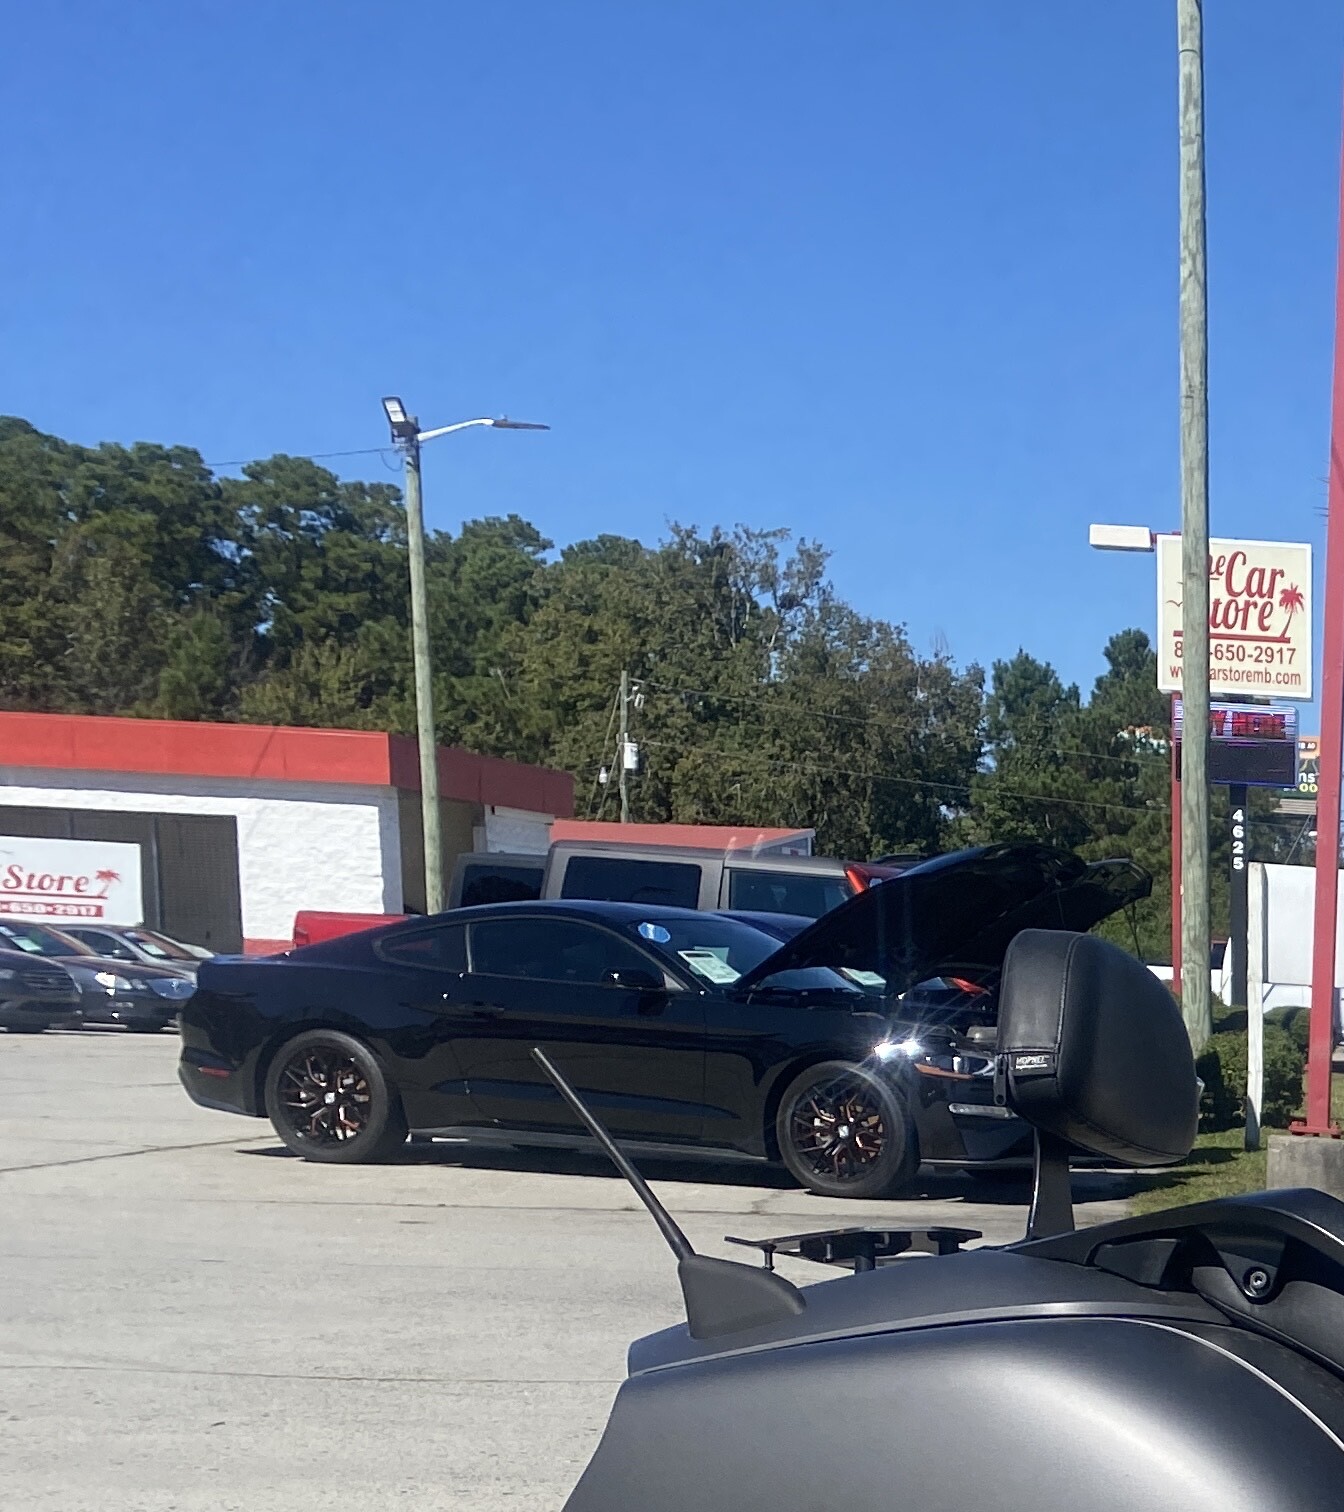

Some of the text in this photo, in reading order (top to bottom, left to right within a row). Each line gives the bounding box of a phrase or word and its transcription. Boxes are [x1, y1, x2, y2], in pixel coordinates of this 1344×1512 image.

[1225, 551, 1285, 599] Car
[1210, 598, 1274, 632] tore
[1174, 641, 1297, 665] 8-650-2917
[1232, 809, 1244, 870] 4625
[3, 865, 90, 892] Store
